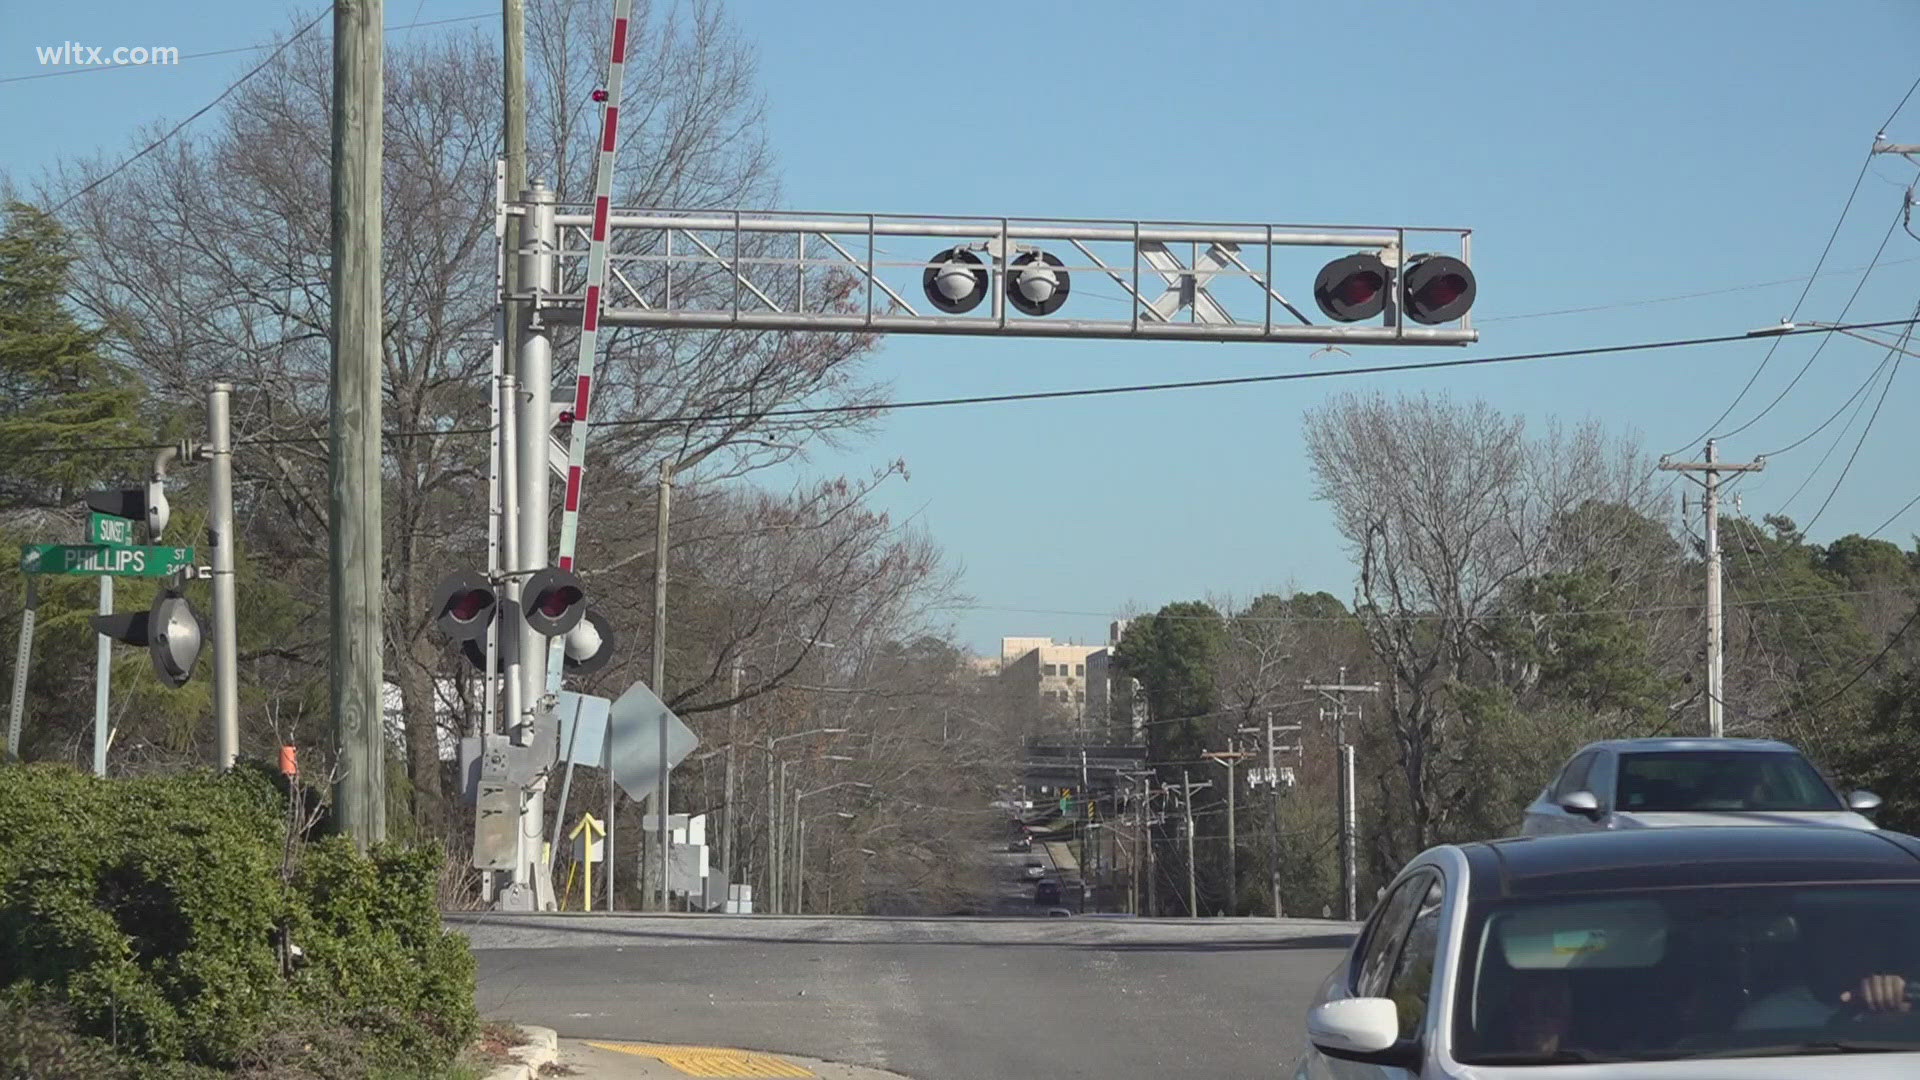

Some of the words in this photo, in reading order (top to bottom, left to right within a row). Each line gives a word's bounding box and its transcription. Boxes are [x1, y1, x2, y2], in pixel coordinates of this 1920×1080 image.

[100, 519, 125, 542] SUNSET
[65, 549, 145, 573] PHILLIPS
[174, 548, 186, 560] ST
